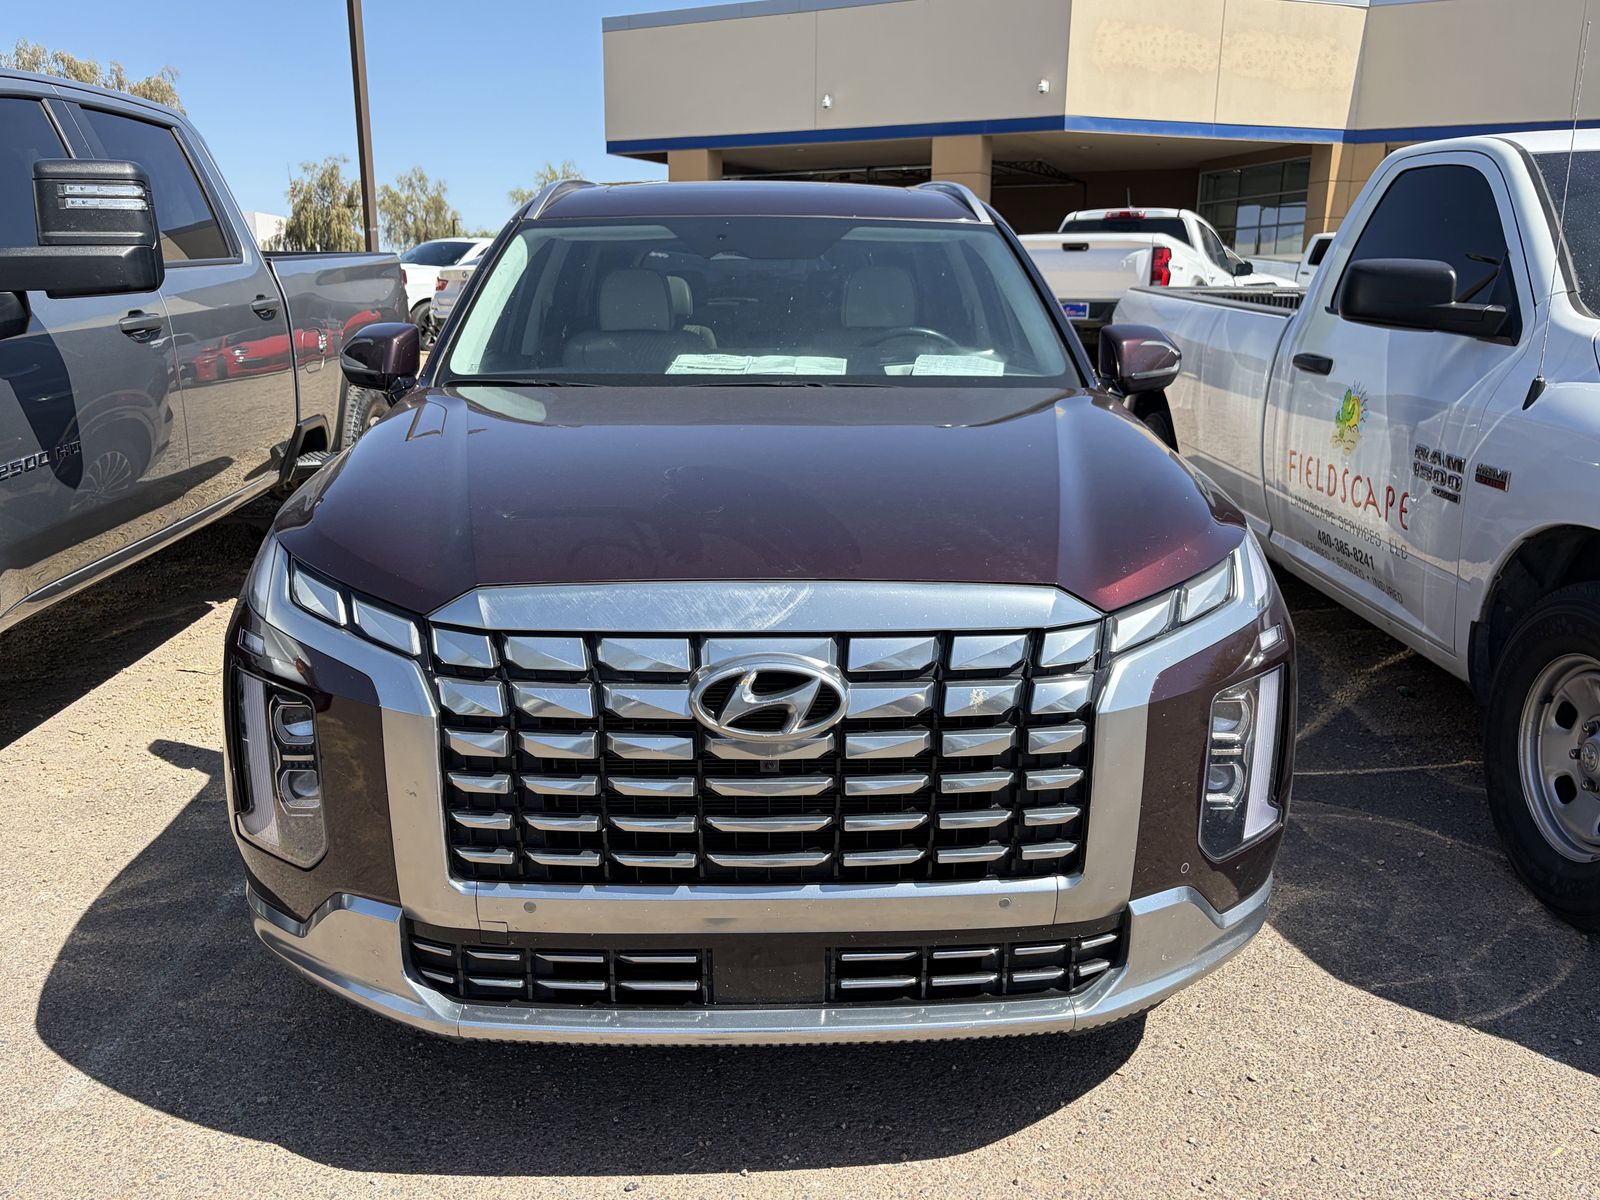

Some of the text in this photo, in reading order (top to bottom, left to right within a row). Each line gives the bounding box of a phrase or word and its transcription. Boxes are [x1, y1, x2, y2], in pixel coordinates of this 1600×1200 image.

[0, 451, 50, 481] 2500
[1414, 442, 1467, 474] RAM
[1288, 450, 1410, 531] FIELDSCAPE
[1413, 461, 1463, 492] 1500
[1290, 492, 1337, 526] LANDSCAPE
[1317, 529, 1375, 571] 480-385-8241
